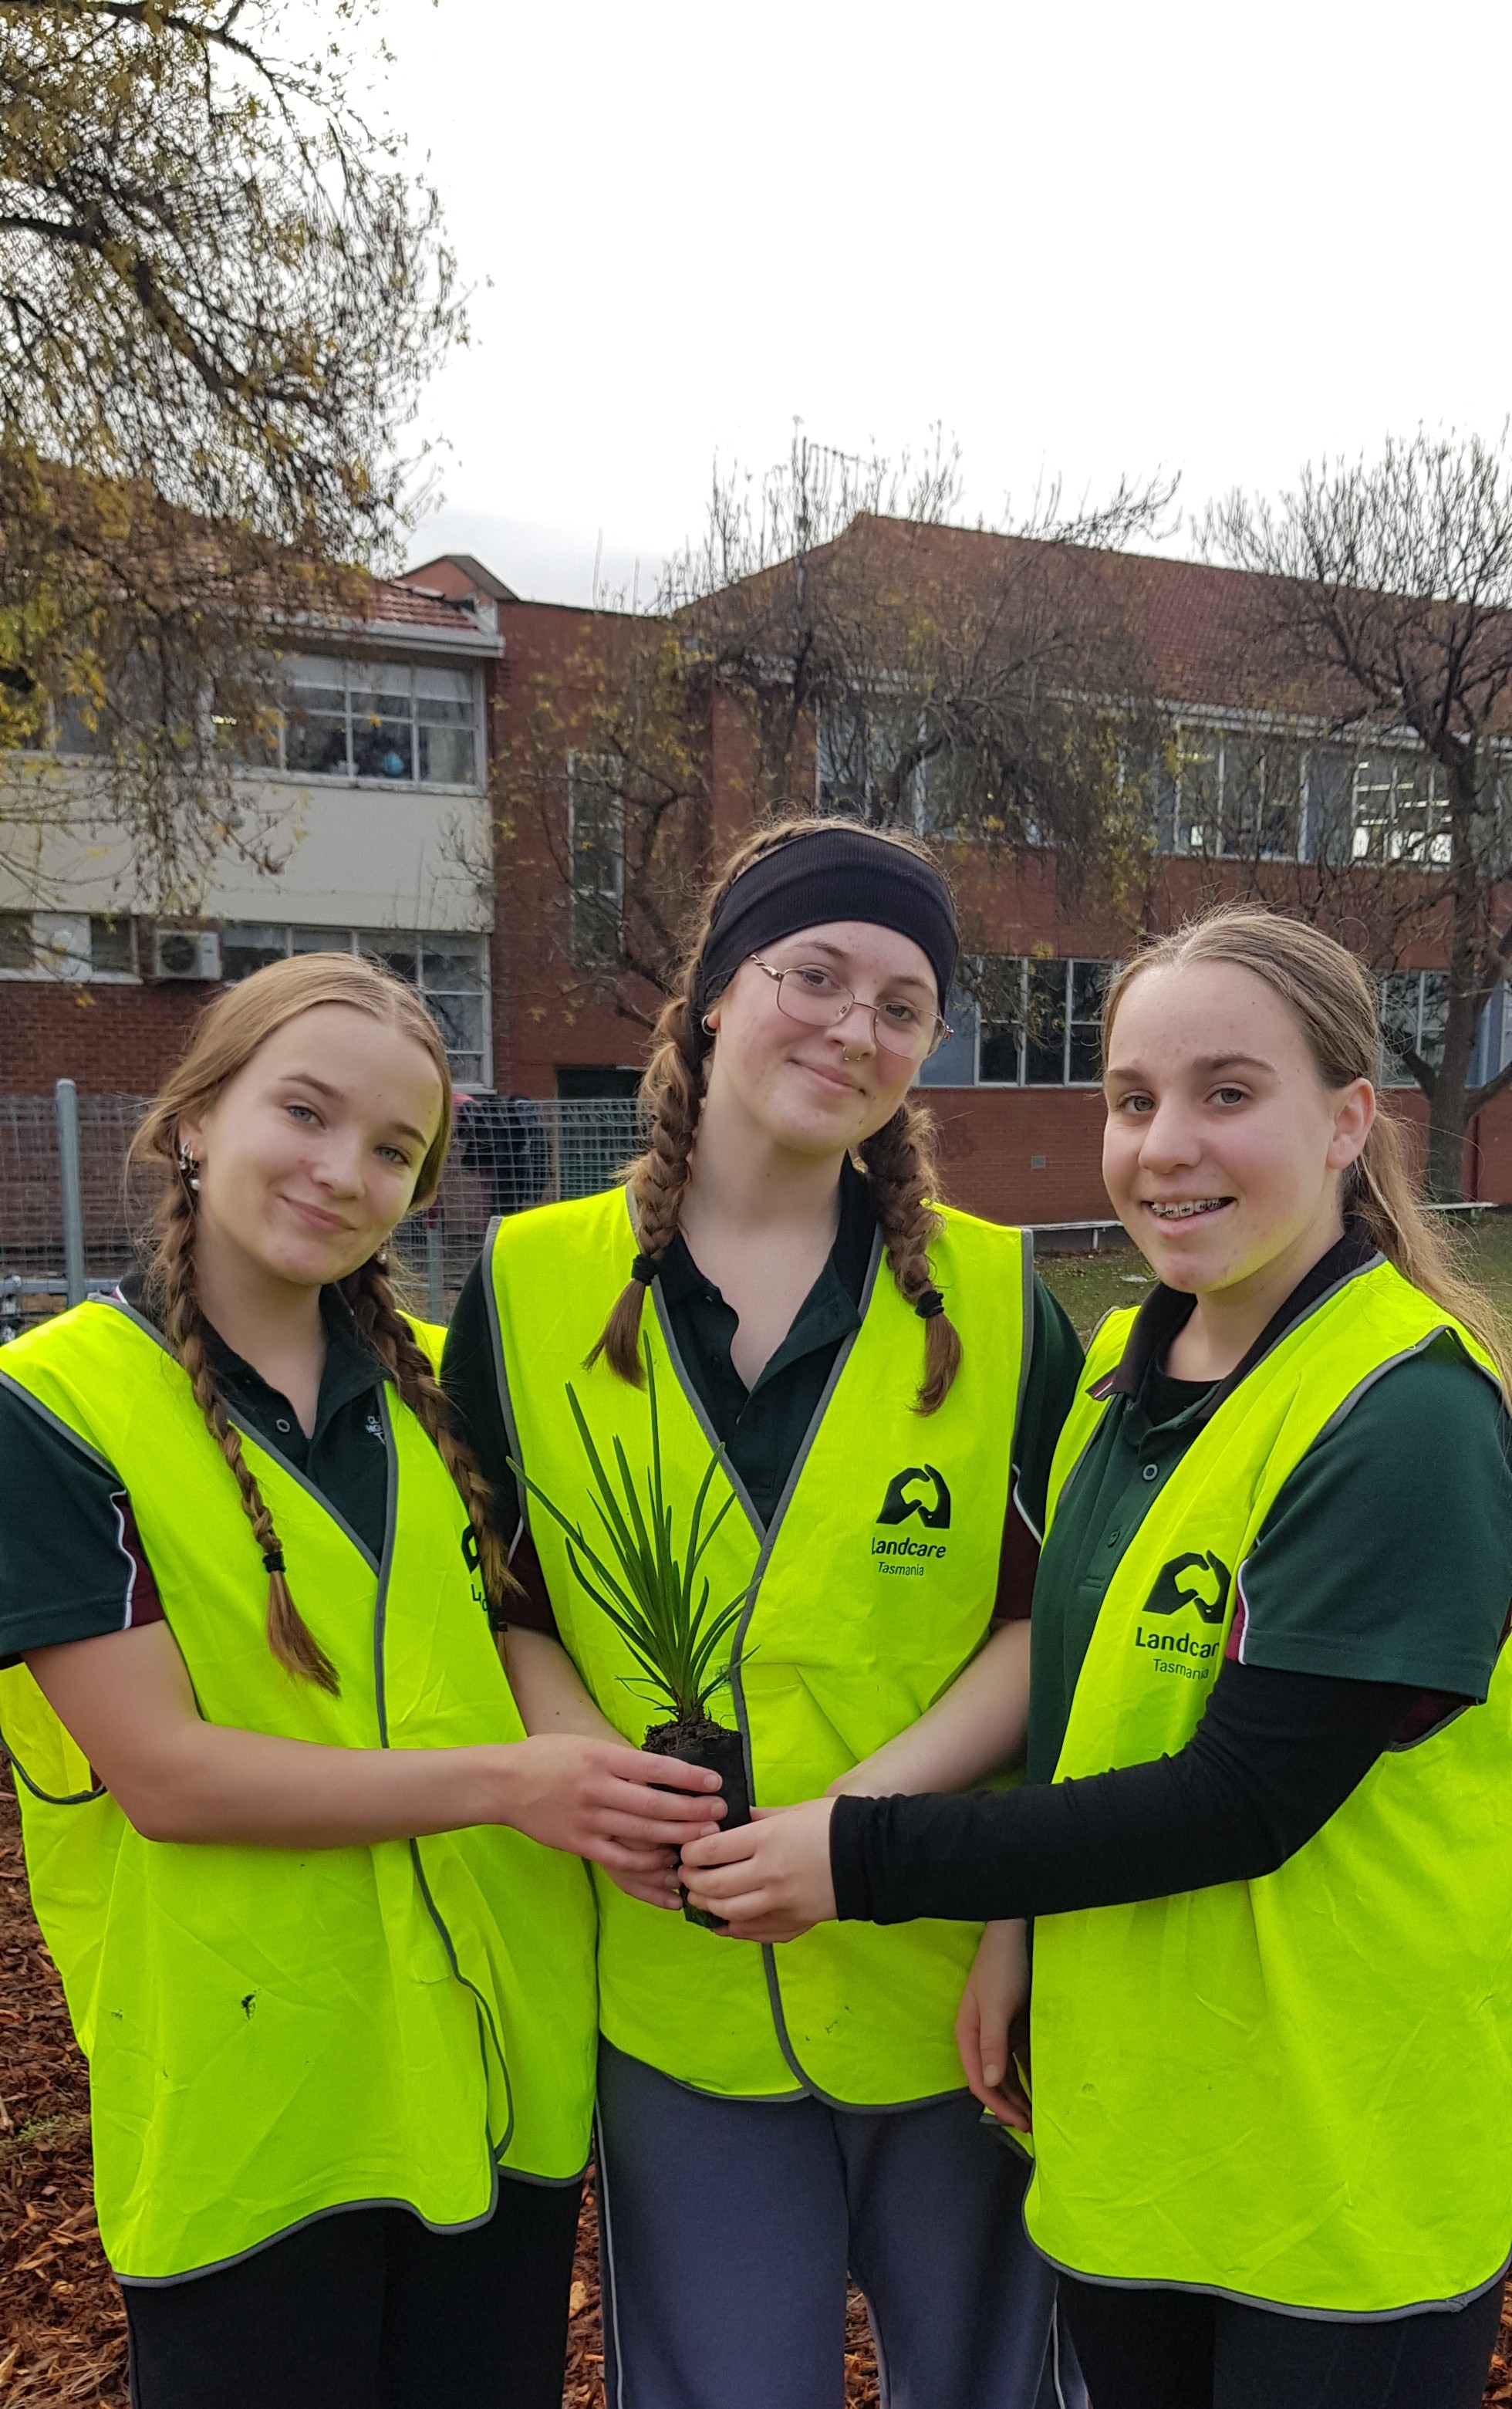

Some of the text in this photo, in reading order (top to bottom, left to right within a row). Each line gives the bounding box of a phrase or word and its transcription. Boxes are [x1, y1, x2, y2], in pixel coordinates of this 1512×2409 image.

[871, 1536, 947, 1559] Landcare
[878, 1561, 924, 1576] Tasmania
[1136, 1627, 1220, 1658] Landcar
[1153, 1657, 1209, 1680] Tasmania
